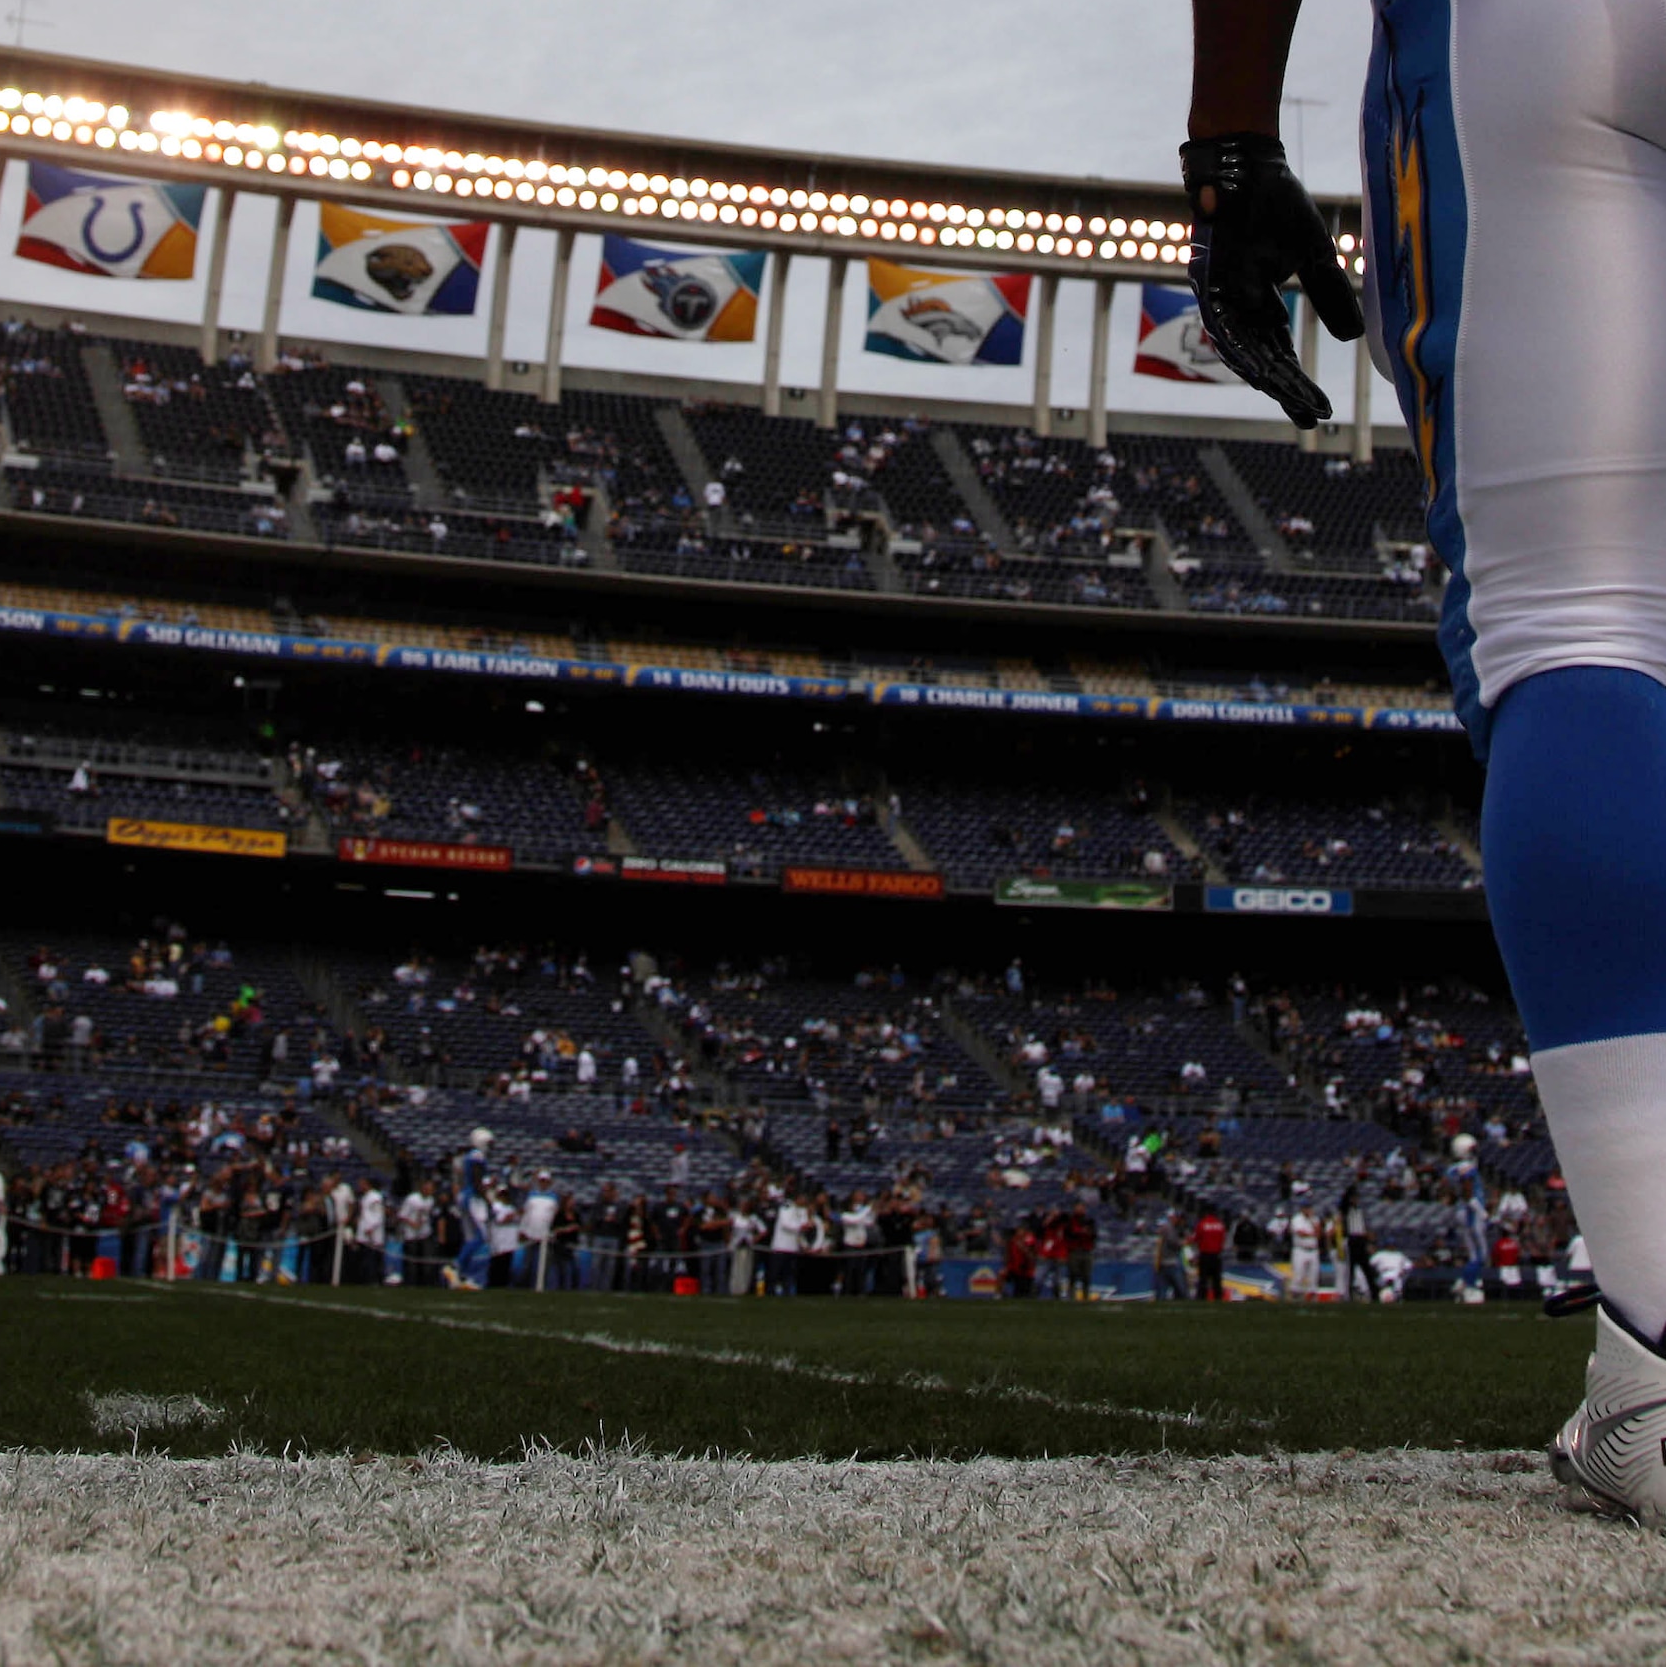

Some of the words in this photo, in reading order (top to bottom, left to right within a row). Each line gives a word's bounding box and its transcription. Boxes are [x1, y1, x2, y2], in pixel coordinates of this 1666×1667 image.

[146, 624, 182, 646] SID
[184, 628, 282, 655] GILLMAN
[679, 671, 727, 692] DAN
[727, 675, 792, 696] FOUTS
[925, 687, 1004, 710] CHARLIE
[1010, 693, 1080, 715] JOINER
[789, 867, 863, 892] WELLS
[866, 872, 941, 896] FARGO
[1233, 887, 1332, 913] GEICO
